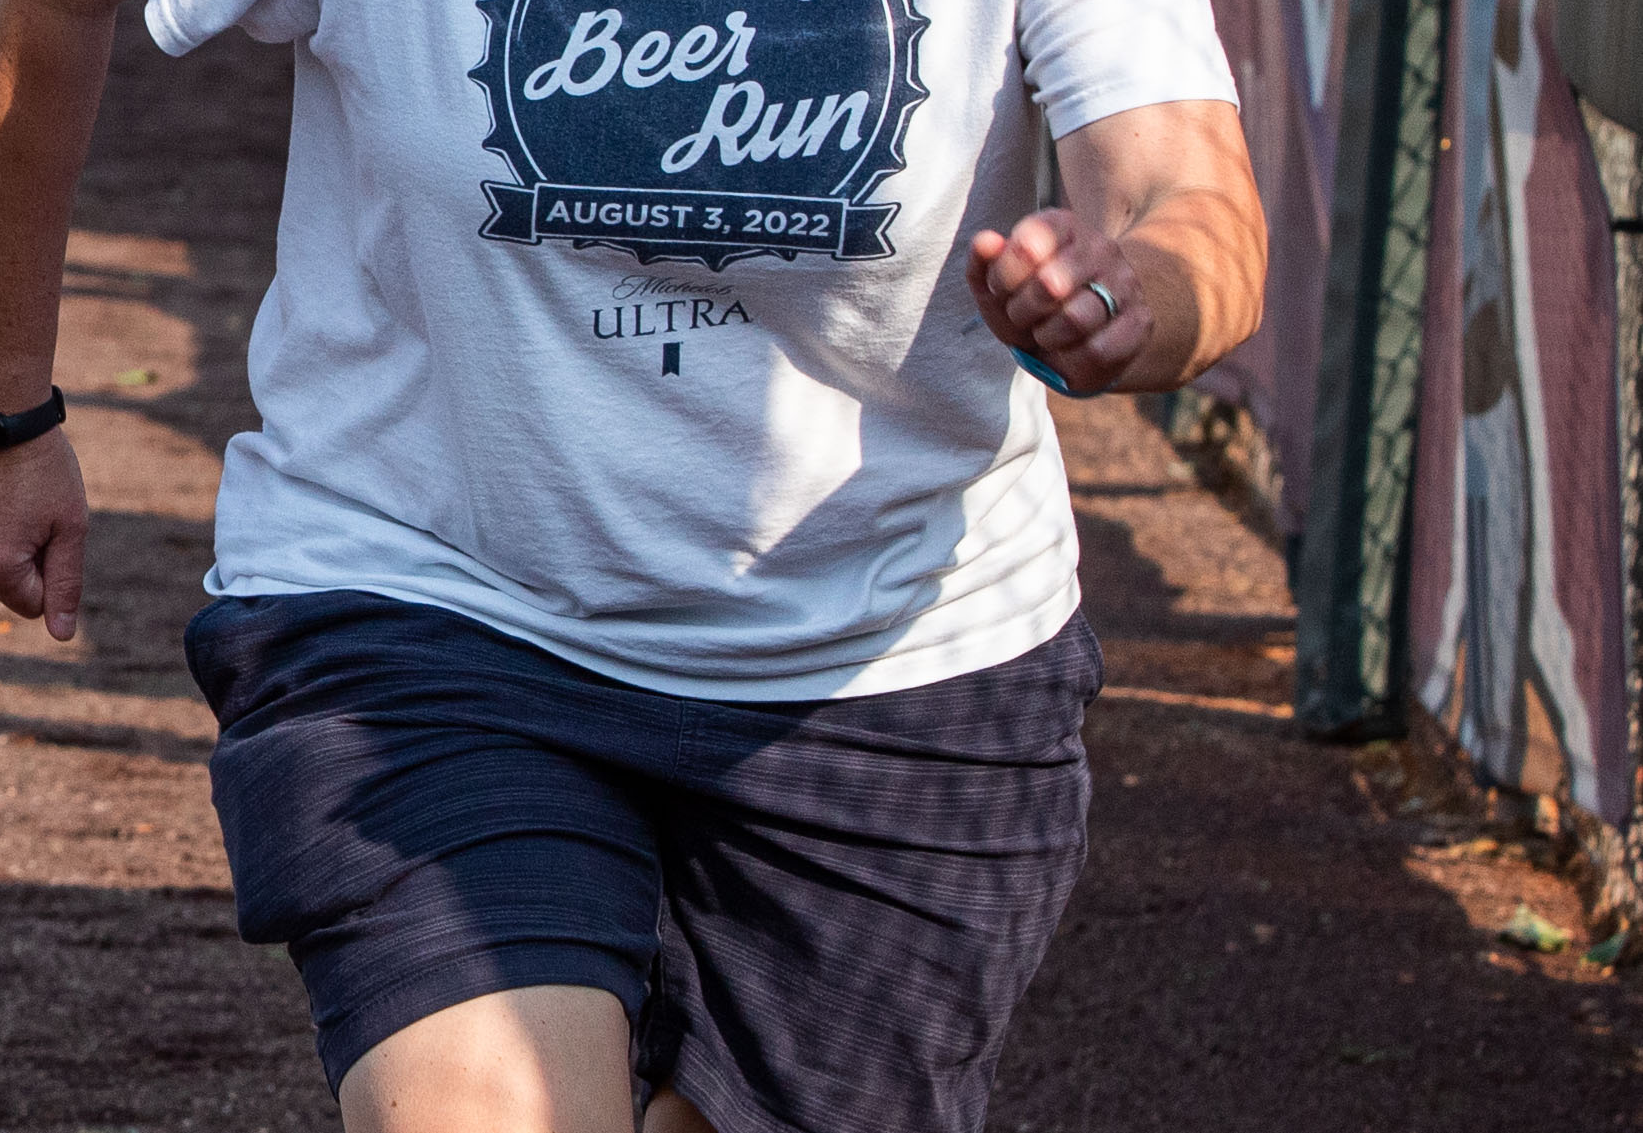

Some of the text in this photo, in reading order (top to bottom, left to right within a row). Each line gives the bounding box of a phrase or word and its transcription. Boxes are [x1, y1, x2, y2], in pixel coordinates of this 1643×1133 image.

[524, 9, 756, 100] Beer
[661, 79, 870, 174] Run
[545, 199, 831, 237] AUGUST 3, 2022
[591, 299, 753, 339] ULTRA
